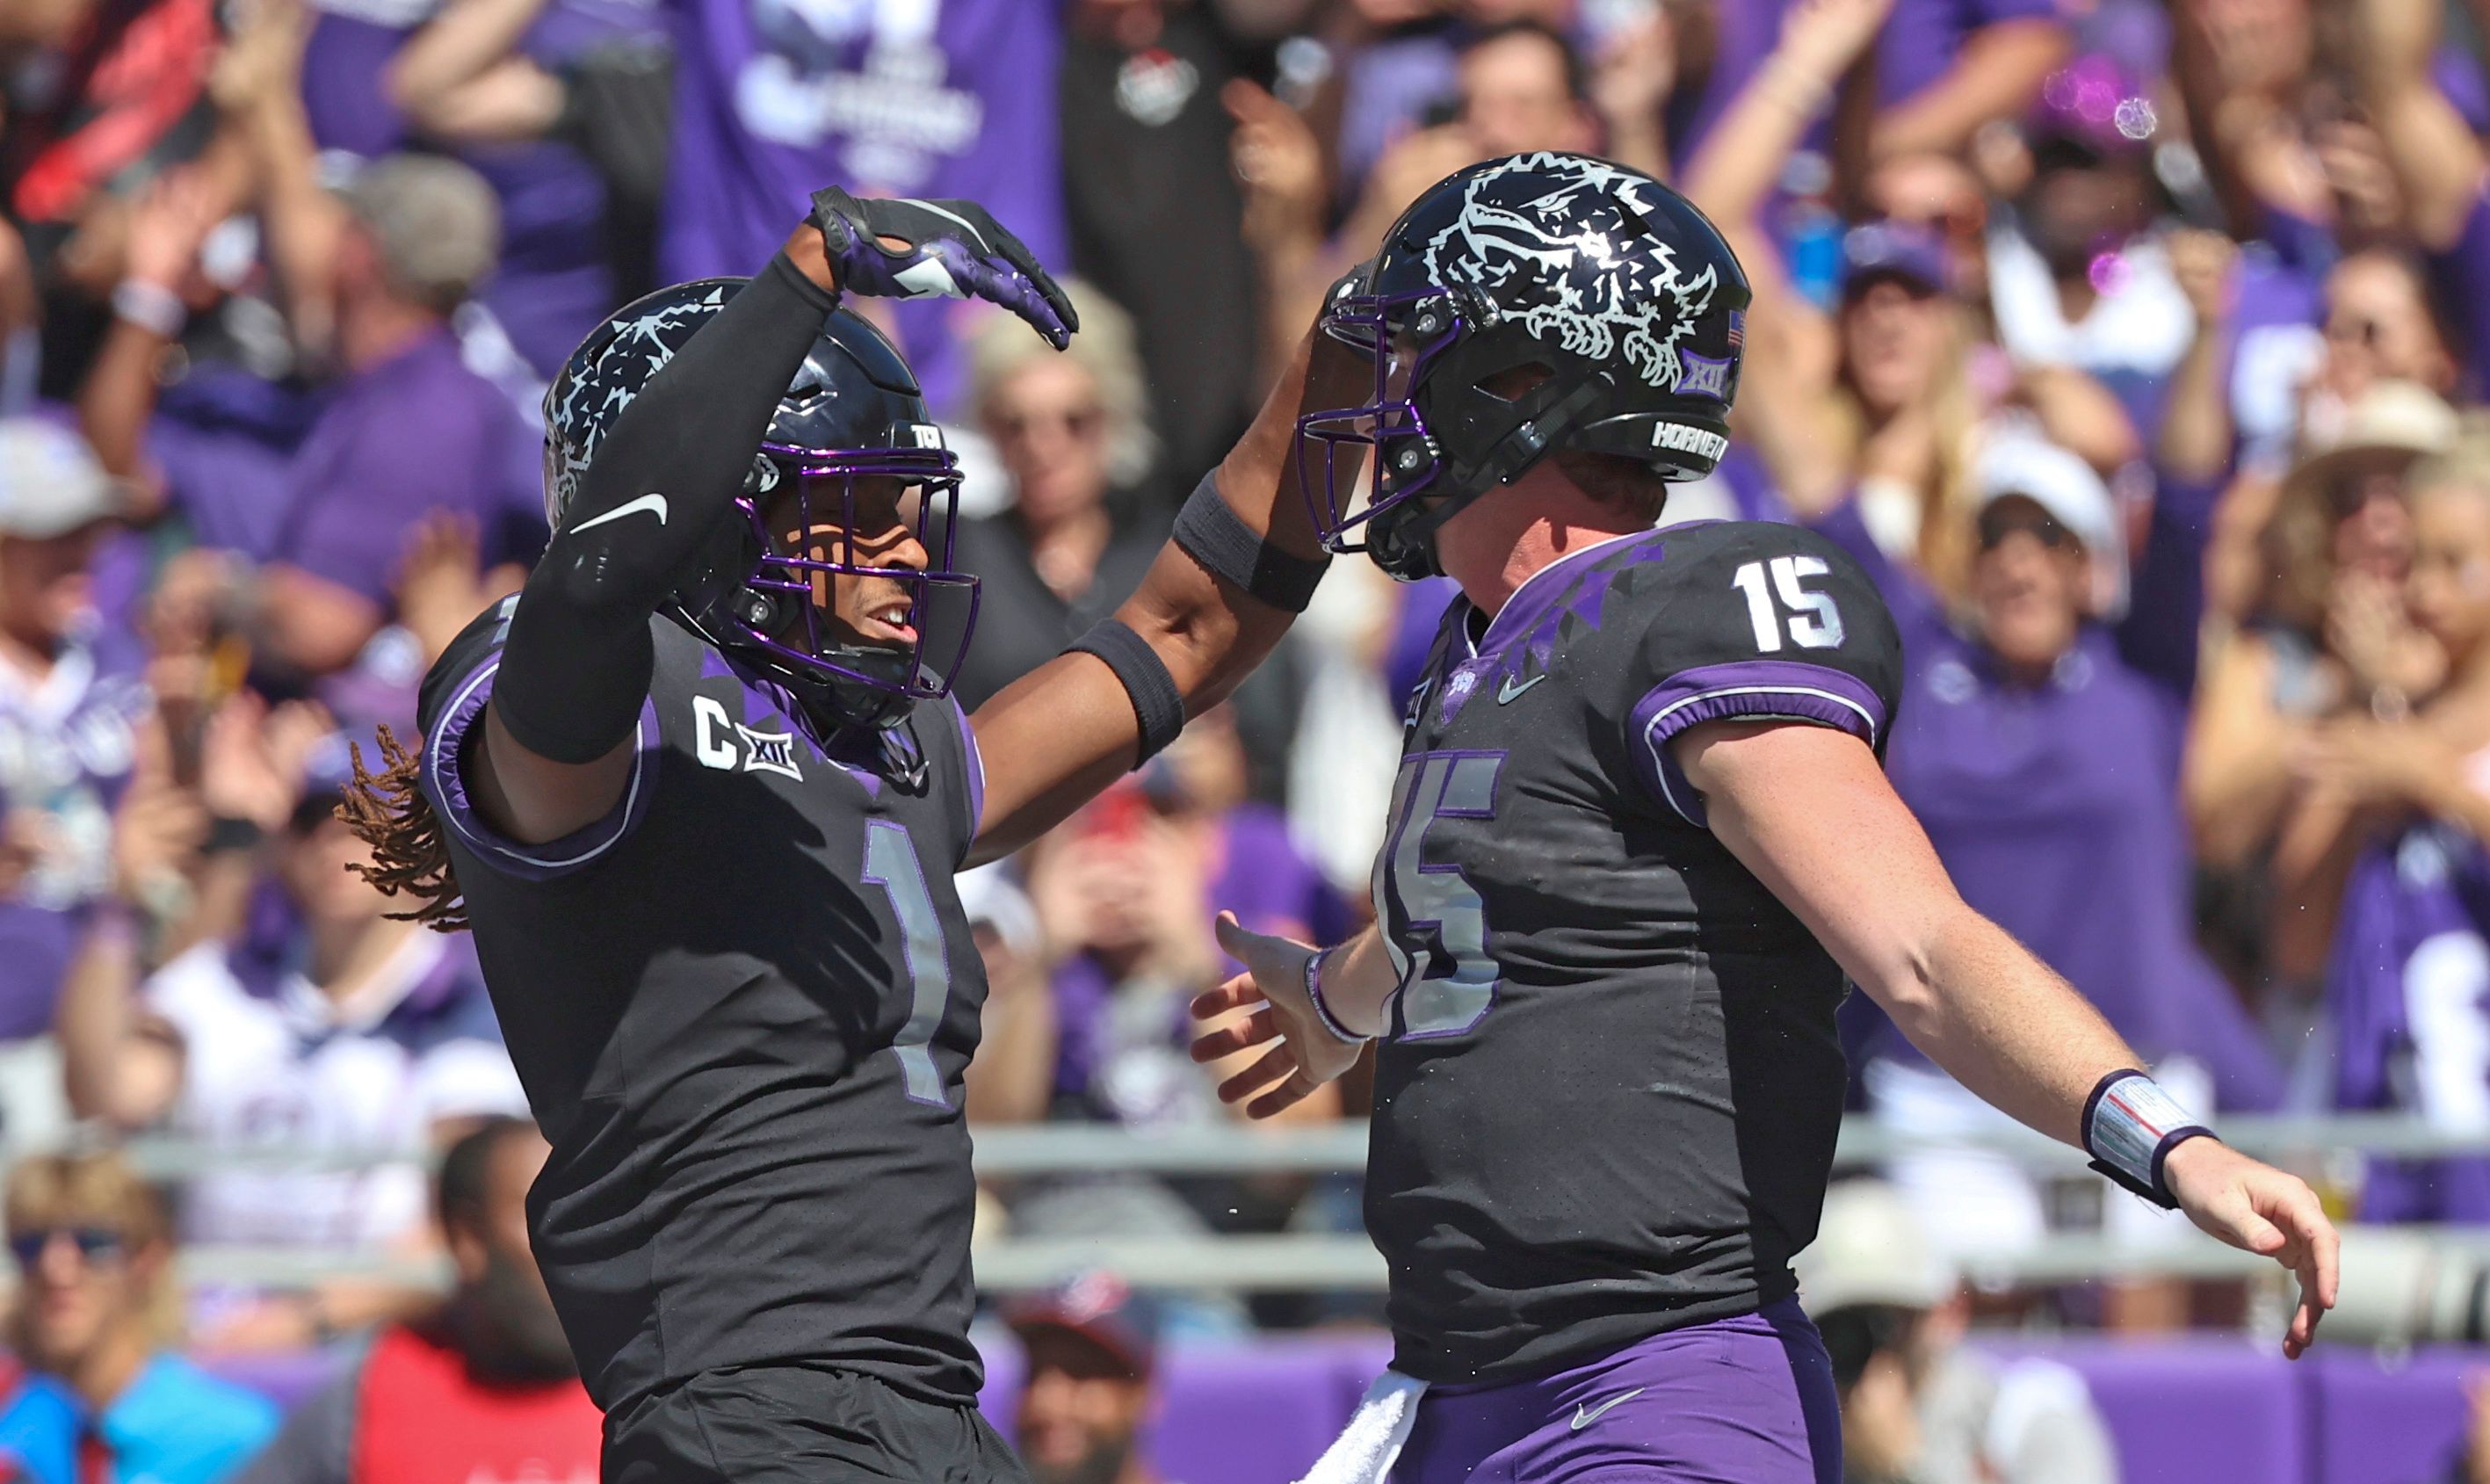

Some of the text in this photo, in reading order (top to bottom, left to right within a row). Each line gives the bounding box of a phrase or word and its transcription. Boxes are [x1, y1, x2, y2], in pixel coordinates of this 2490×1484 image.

[1680, 353, 1727, 399] XII
[1731, 555, 1845, 650] 15
[692, 695, 797, 773] C XII
[1371, 749, 1509, 1042] 15
[860, 818, 956, 1111] 1
